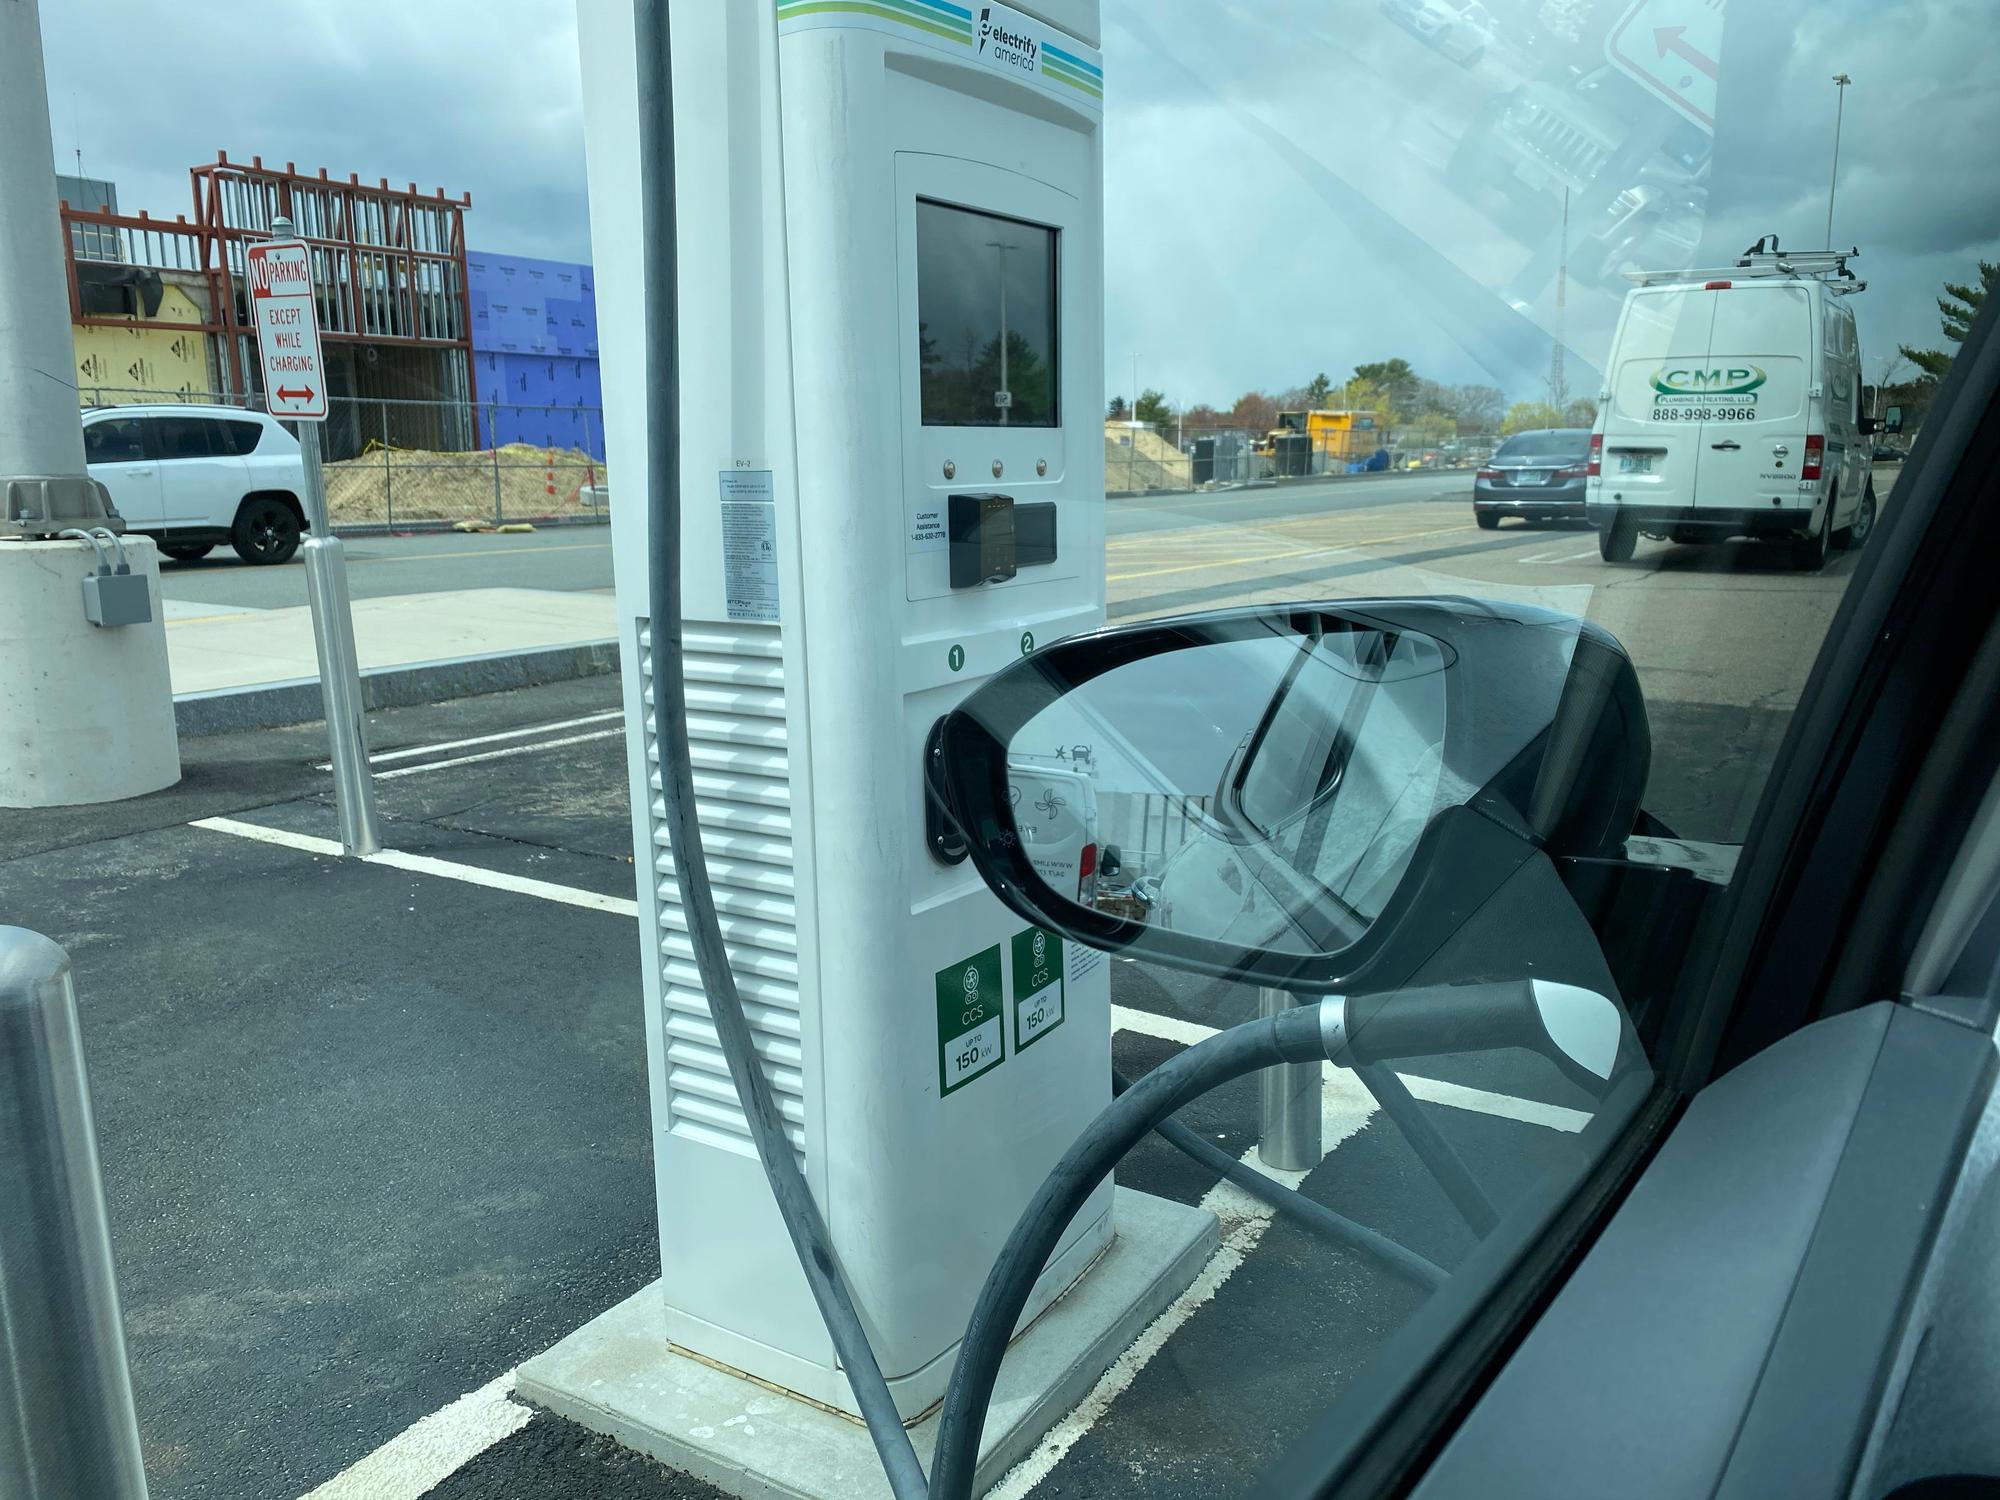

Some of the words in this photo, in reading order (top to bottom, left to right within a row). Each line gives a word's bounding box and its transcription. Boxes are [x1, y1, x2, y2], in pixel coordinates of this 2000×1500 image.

[993, 26, 1037, 59] electrify
[994, 45, 1034, 71] america
[250, 256, 269, 290] NO
[269, 259, 307, 283] PARKING
[269, 308, 301, 325] EXCEPT
[275, 332, 301, 348] WHILE
[270, 356, 313, 372] CHARGING
[1666, 369, 1751, 387] CMP
[1653, 408, 1756, 421] 888-998-9966
[1023, 635, 1031, 651] 2
[953, 649, 959, 667] 1
[1031, 967, 1049, 987] CCS
[961, 1004, 984, 1025] CCS
[1026, 1007, 1044, 1030] 150
[955, 1047, 979, 1071] 150
[980, 1044, 993, 1058] kW
